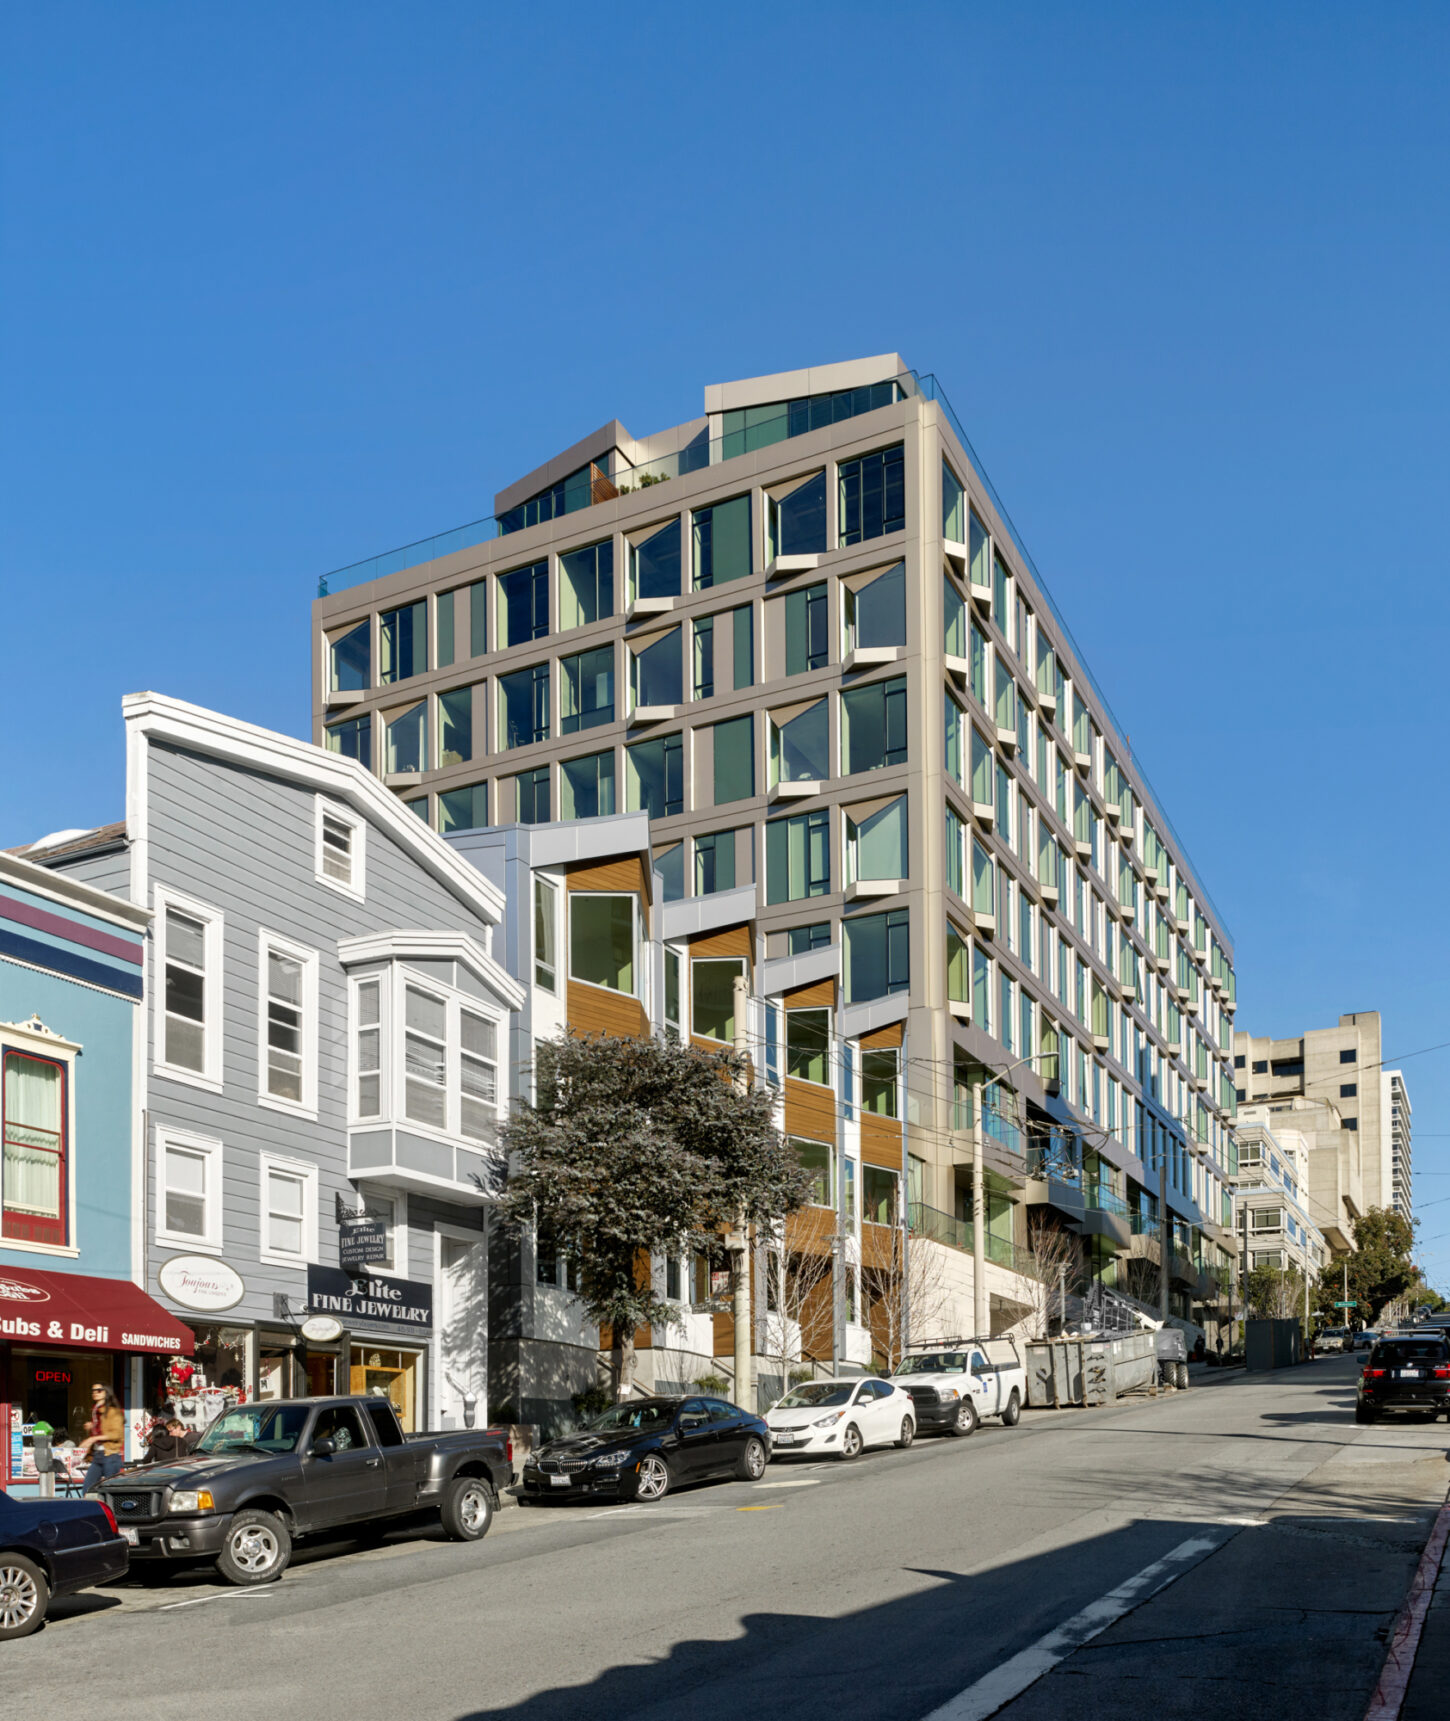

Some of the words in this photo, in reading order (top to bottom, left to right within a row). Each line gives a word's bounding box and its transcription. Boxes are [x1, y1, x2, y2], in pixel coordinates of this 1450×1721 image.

[352, 1226, 375, 1235] Elite
[341, 1236, 355, 1249] FINE
[357, 1234, 384, 1245] JEWELRY
[342, 1255, 364, 1263] JEWELRY
[344, 1278, 402, 1301] Elite
[312, 1293, 352, 1312] FINE
[356, 1300, 429, 1322] JEWELRY
[47, 1320, 64, 1339] &
[70, 1323, 109, 1343] Deli
[121, 1332, 181, 1350] SANDWICHES
[36, 1370, 71, 1383] OPEN
